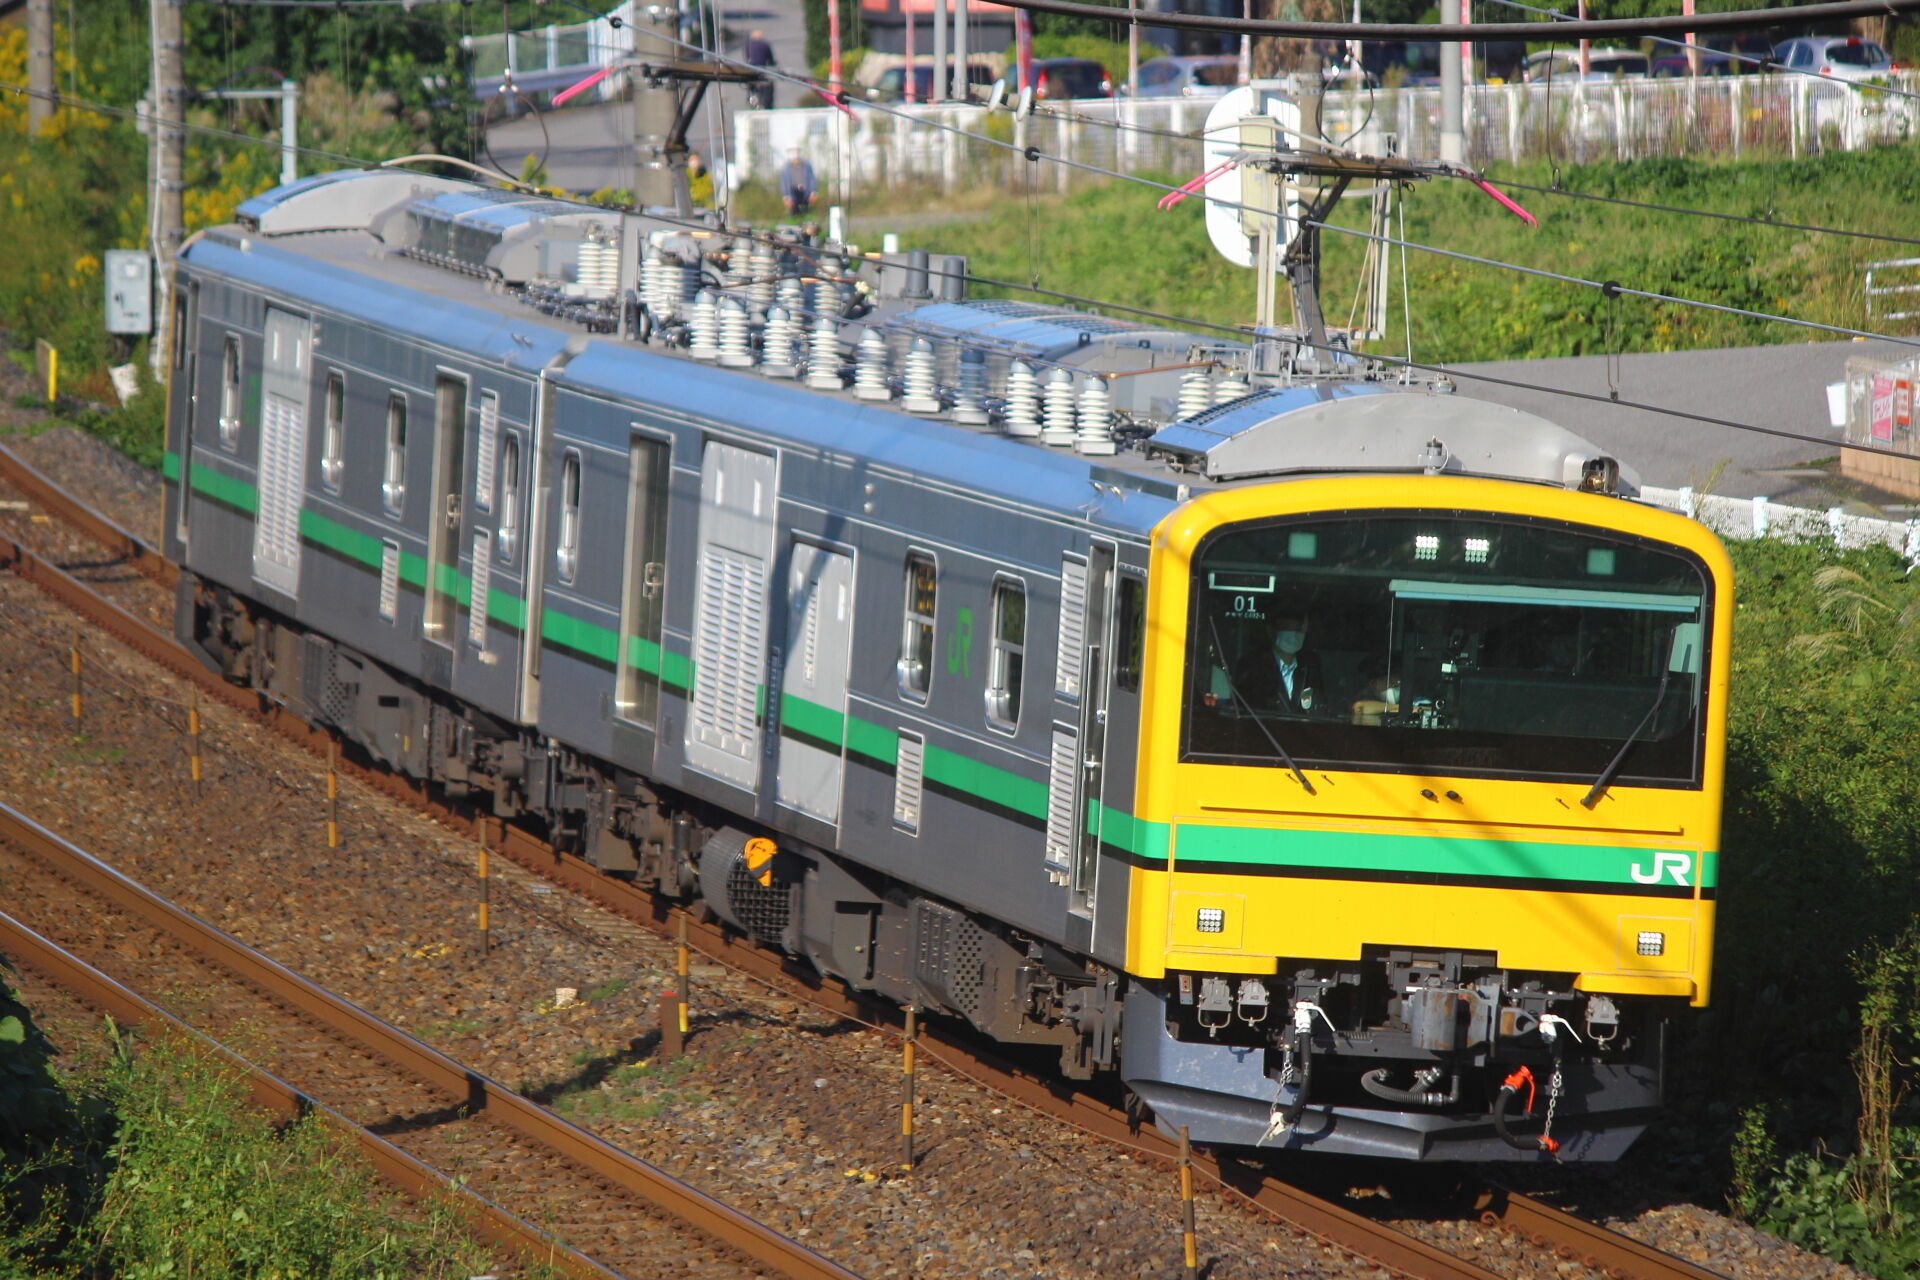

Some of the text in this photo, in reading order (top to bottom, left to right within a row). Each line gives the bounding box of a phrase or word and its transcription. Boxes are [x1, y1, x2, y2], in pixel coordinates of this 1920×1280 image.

[1234, 595, 1256, 612] 01
[946, 607, 973, 679] JR
[1631, 852, 1691, 886] JR
